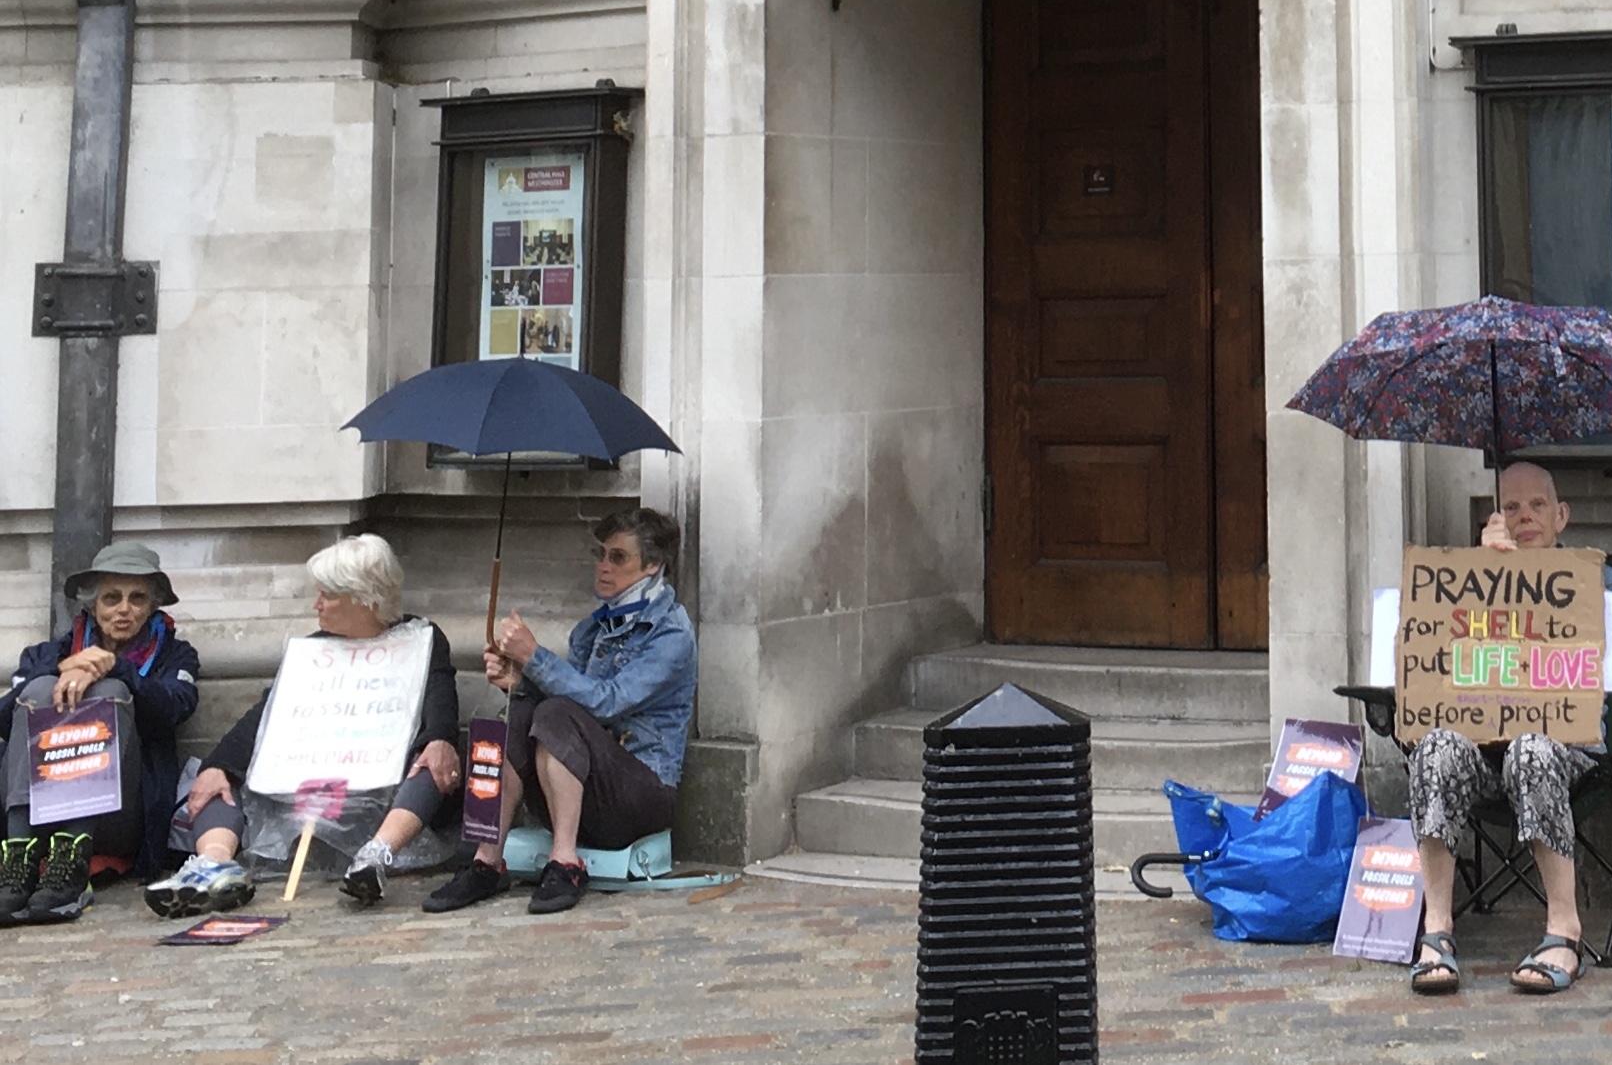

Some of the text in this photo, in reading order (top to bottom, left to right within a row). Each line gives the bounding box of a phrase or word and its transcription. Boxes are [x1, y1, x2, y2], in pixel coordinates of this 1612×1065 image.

[1411, 565, 1576, 608] PRAYING
[1403, 609, 1577, 644] for SHELL to
[1404, 647, 1451, 689] put
[1453, 644, 1519, 686] LIFE
[1530, 646, 1600, 690] LOVE
[292, 703, 358, 719] FOSSIL
[1403, 696, 1577, 737] before profit
[50, 726, 98, 745] BEYOND
[44, 742, 105, 761] FOSSIL FUELS
[49, 757, 101, 775] TOGETHER
[1371, 851, 1414, 867] BEYOND
[1362, 870, 1415, 886] FOSSIL FUELS
[1362, 886, 1409, 904] TOGETHER
